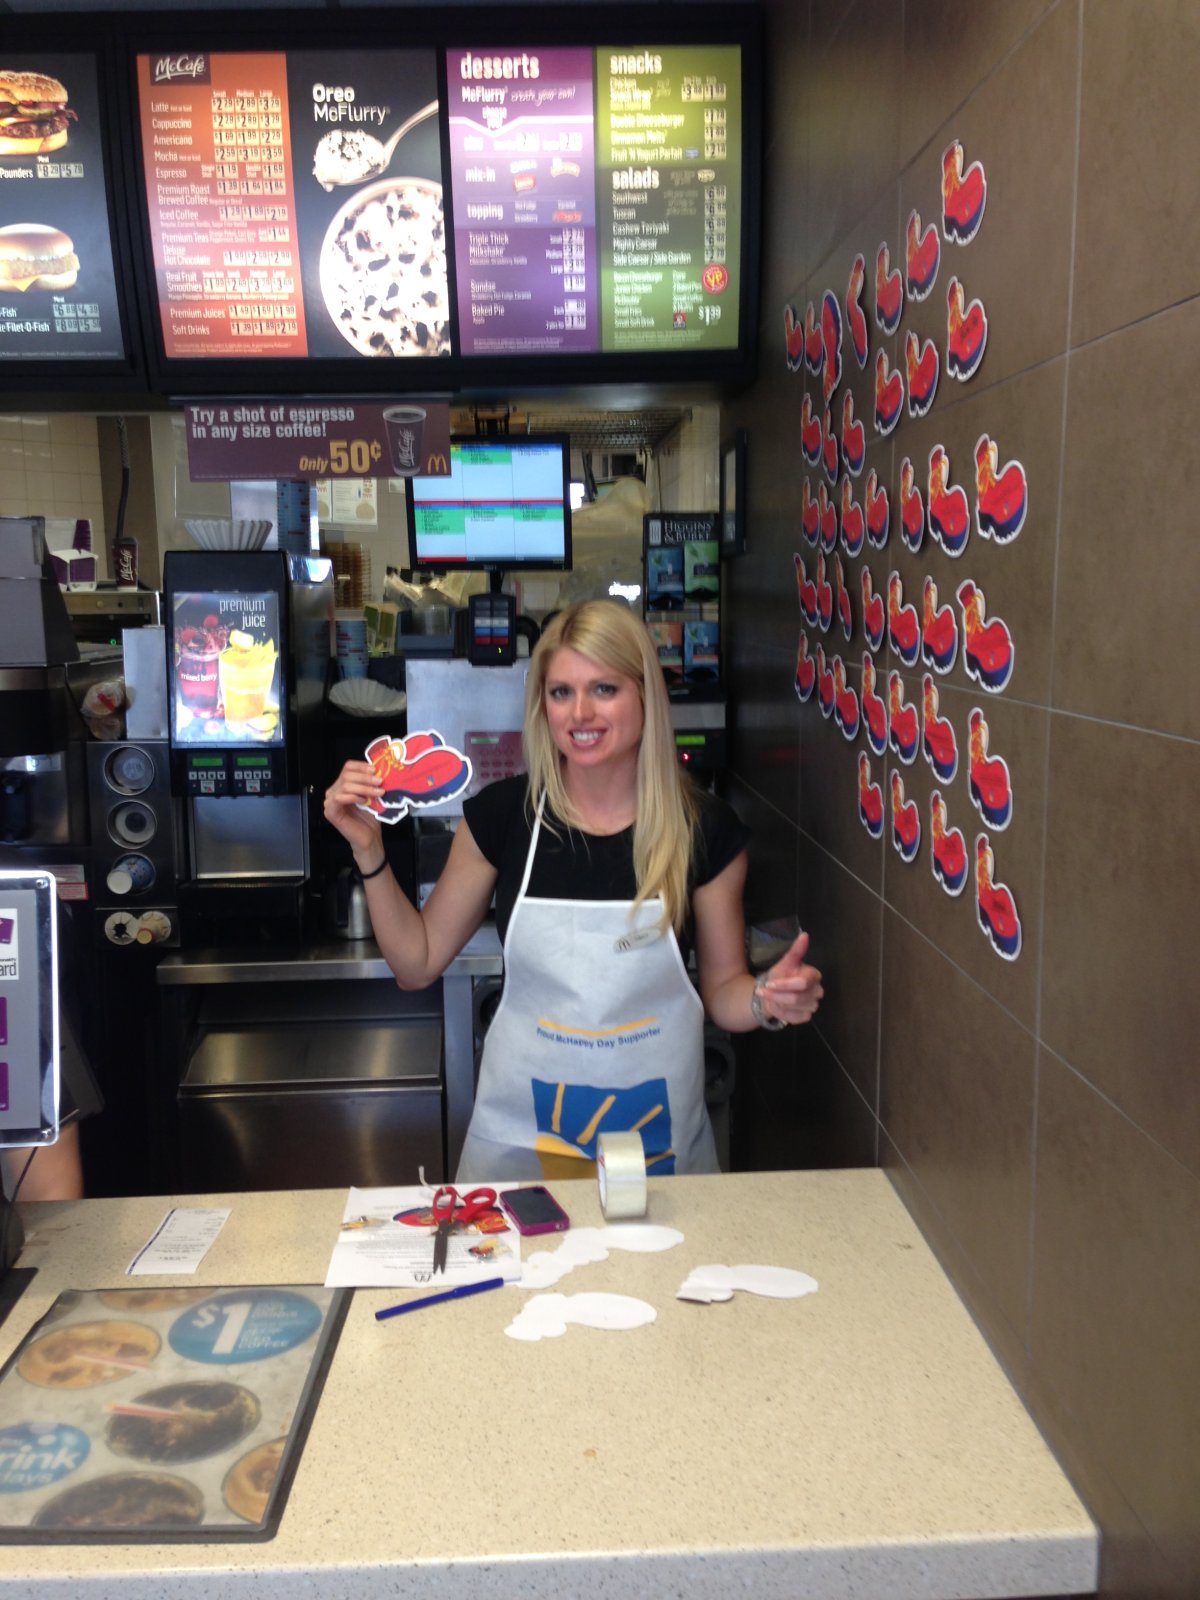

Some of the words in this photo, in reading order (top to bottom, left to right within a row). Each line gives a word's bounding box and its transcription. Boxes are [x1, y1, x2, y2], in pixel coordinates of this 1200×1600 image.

[461, 52, 540, 79] desserts
[611, 51, 662, 74] snacks
[312, 83, 355, 102] Oreo
[152, 101, 169, 113] Latte
[152, 118, 192, 130] Cappuccino
[154, 135, 193, 146] Americano
[155, 151, 178, 162] Mocha
[156, 168, 187, 180] Espresso
[612, 166, 659, 189] salads
[158, 184, 190, 195] Premium
[191, 184, 210, 195] Roast
[185, 194, 209, 206] Coffee
[176, 209, 199, 221] Coffee
[467, 203, 503, 220] topping
[471, 280, 496, 293] Sundae
[170, 308, 203, 319] Premium
[204, 306, 226, 319] Juices
[173, 323, 188, 335] Soft
[189, 323, 210, 335] Drinks
[190, 407, 214, 426] Try
[220, 410, 229, 422] a
[234, 407, 265, 422] shot
[270, 408, 285, 421] of
[289, 408, 354, 425] espresso
[192, 425, 206, 438] in
[211, 427, 236, 441] any
[243, 424, 270, 438] size
[276, 423, 326, 438] coffee!
[299, 455, 328, 474] Only
[329, 440, 381, 473] 50¢
[219, 598, 266, 614] premium
[242, 612, 266, 630] juice
[181, 673, 200, 682] mixed
[200, 674, 218, 683] berry
[556, 1034, 594, 1049] McHappy
[597, 1038, 615, 1049] Day
[617, 1026, 661, 1046] Supporter
[192, 1302, 253, 1355] $1
